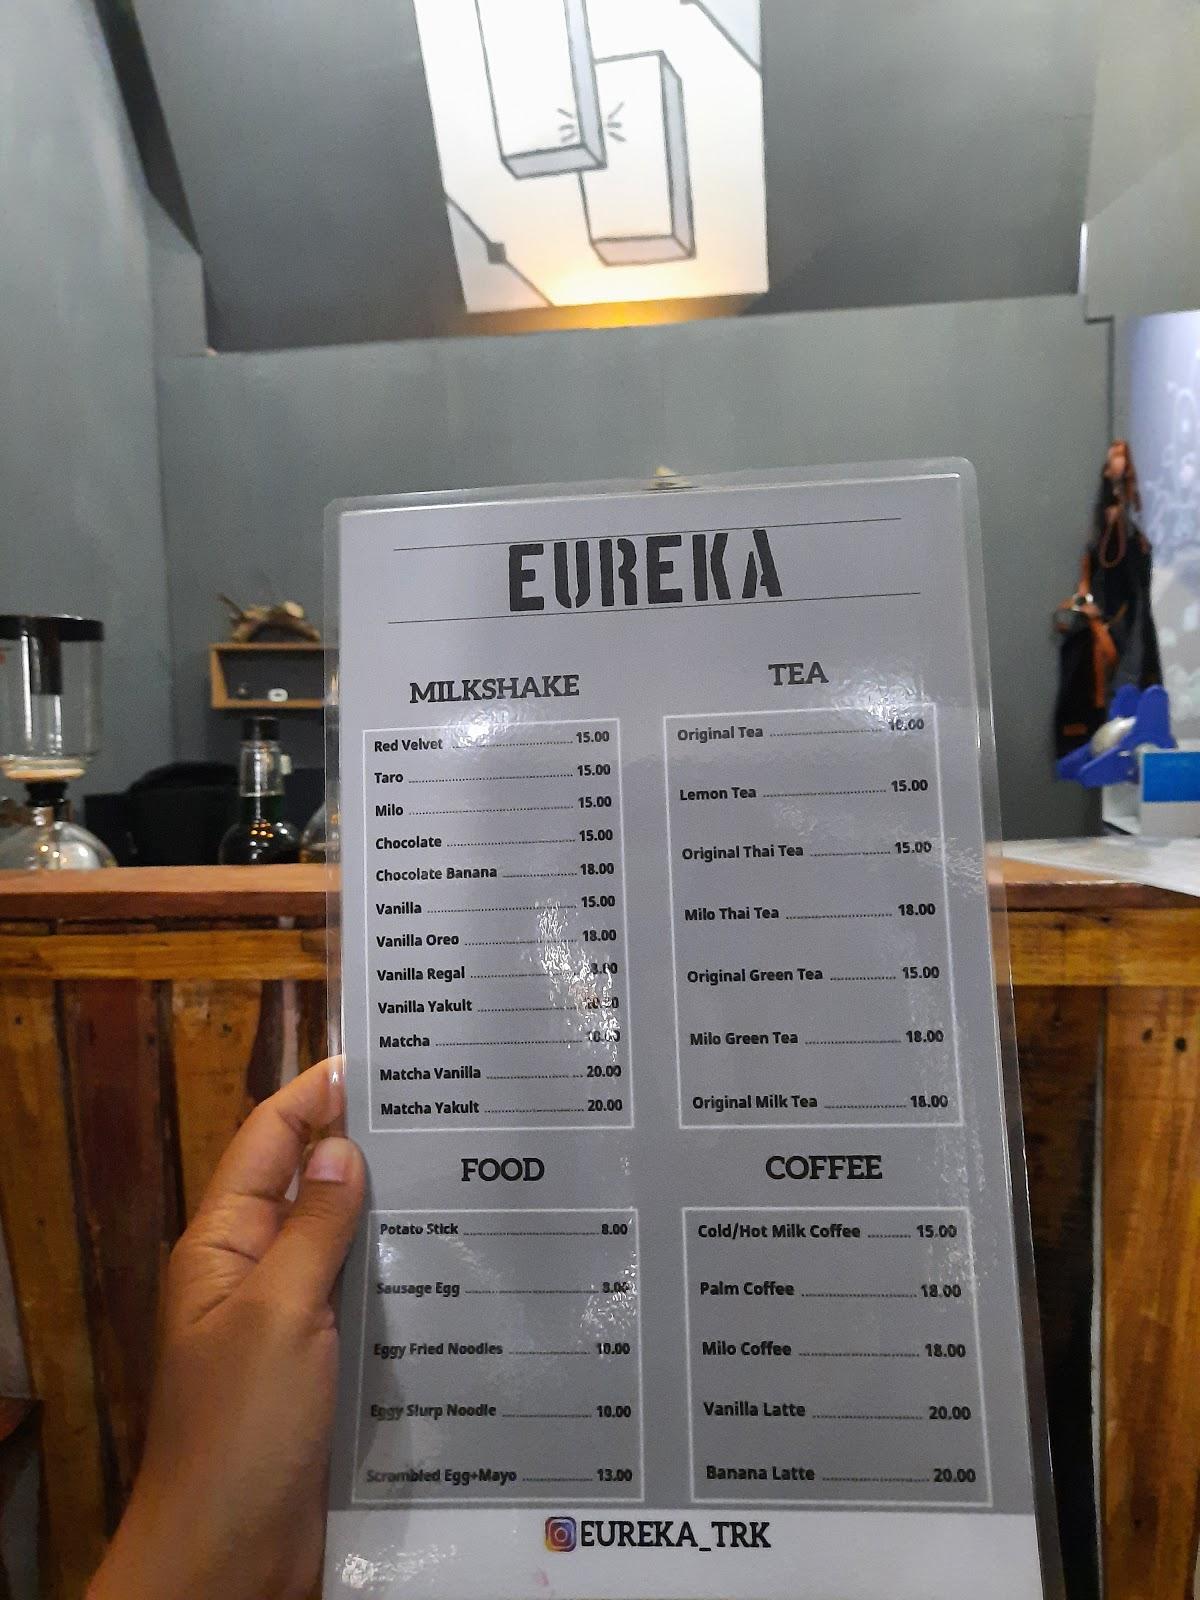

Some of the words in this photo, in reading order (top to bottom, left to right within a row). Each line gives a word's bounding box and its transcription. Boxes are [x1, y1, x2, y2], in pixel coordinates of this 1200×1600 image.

[508, 529, 782, 612] EUREKA
[768, 662, 829, 686] TEA
[409, 674, 580, 703] MILKSHAKE
[374, 740, 398, 752] Red
[402, 738, 443, 751] Velvet
[576, 731, 610, 744] 15.00
[677, 726, 735, 743] Original
[738, 726, 763, 739] Tea
[374, 772, 404, 784] Taro
[577, 764, 610, 777] 15.00
[680, 788, 728, 801] Lemon
[731, 787, 757, 799] Tea
[891, 779, 928, 793] 15.00
[375, 804, 404, 817] Milo
[578, 796, 612, 809] 15.00
[375, 836, 442, 850] Chocolate
[579, 829, 613, 842] 15.00
[682, 845, 740, 862] Original
[743, 845, 775, 858] Thai
[778, 844, 804, 857] Tea
[894, 841, 932, 854] 15.00
[375, 868, 443, 882] Chocolate
[446, 867, 497, 879] Banana
[580, 863, 614, 875] 18.00
[376, 903, 422, 915] Vanilla
[581, 895, 616, 908] 15.00
[685, 908, 716, 921] Milo
[719, 907, 750, 920] Thai
[753, 907, 779, 919] Tea
[898, 903, 936, 916] 18.00
[376, 935, 423, 948] Vanilla
[426, 935, 459, 946] Oreo
[582, 929, 617, 942] 18.00
[377, 969, 424, 982] Vanilla
[427, 966, 465, 983] Regal
[687, 969, 746, 985] Original
[749, 969, 794, 982] Green
[797, 968, 823, 980] Tea
[903, 966, 940, 979] 15.00
[378, 1001, 425, 1014] Vanilla
[428, 999, 472, 1013] Yakult
[379, 1035, 430, 1048] Matcha
[690, 1032, 721, 1045] Milo
[725, 1032, 770, 1045] Green
[772, 1031, 798, 1044] Tea
[906, 1030, 944, 1043] 18.00
[380, 1068, 431, 1081] Matcha
[434, 1066, 481, 1080] Vanilla
[586, 1065, 621, 1078] 20.00
[381, 1102, 432, 1115] Matcha
[435, 1100, 480, 1114] Yakult
[588, 1099, 623, 1112] 20.00
[692, 1095, 752, 1112] Original
[755, 1095, 788, 1108] Milk
[791, 1095, 817, 1108] Tea
[910, 1095, 948, 1108] 18.00
[461, 1158, 545, 1182] FOOD
[766, 1155, 882, 1180] COFFEE
[380, 1223, 423, 1235] Potato
[426, 1223, 458, 1235] Stick
[601, 1224, 628, 1235] 8.00
[698, 1222, 768, 1240] Cold/Hot
[772, 1224, 806, 1238] Milk
[809, 1224, 860, 1238] Coffee
[916, 1224, 957, 1238] 15.00
[377, 1283, 432, 1297] Sausage
[435, 1282, 460, 1297] Egg
[700, 1282, 740, 1296] Palm
[744, 1281, 795, 1296] Coffee
[920, 1284, 962, 1298] 18.00
[374, 1344, 406, 1359] Eggy
[410, 1343, 444, 1355] Fried
[449, 1343, 503, 1355] Noodles
[597, 1343, 630, 1355] 10.00
[702, 1342, 736, 1356] Milo
[740, 1341, 792, 1355] Coffee
[925, 1343, 966, 1358] 18.00
[371, 1405, 404, 1421] Eggy
[406, 1405, 443, 1420] Slurp
[447, 1405, 497, 1417] Noodle
[597, 1405, 631, 1418] 10.00
[704, 1402, 759, 1417] Vanilla
[763, 1402, 806, 1417] Latte
[929, 1406, 971, 1420] 20.00
[366, 1469, 441, 1483] Scrambled
[444, 1469, 517, 1485] Egg+Mayo
[597, 1469, 632, 1482] 13.00
[706, 1466, 768, 1480] Banana
[772, 1466, 815, 1481] Latte
[933, 1468, 976, 1483] 20.00
[581, 1521, 771, 1551] EUREKA_TRK
